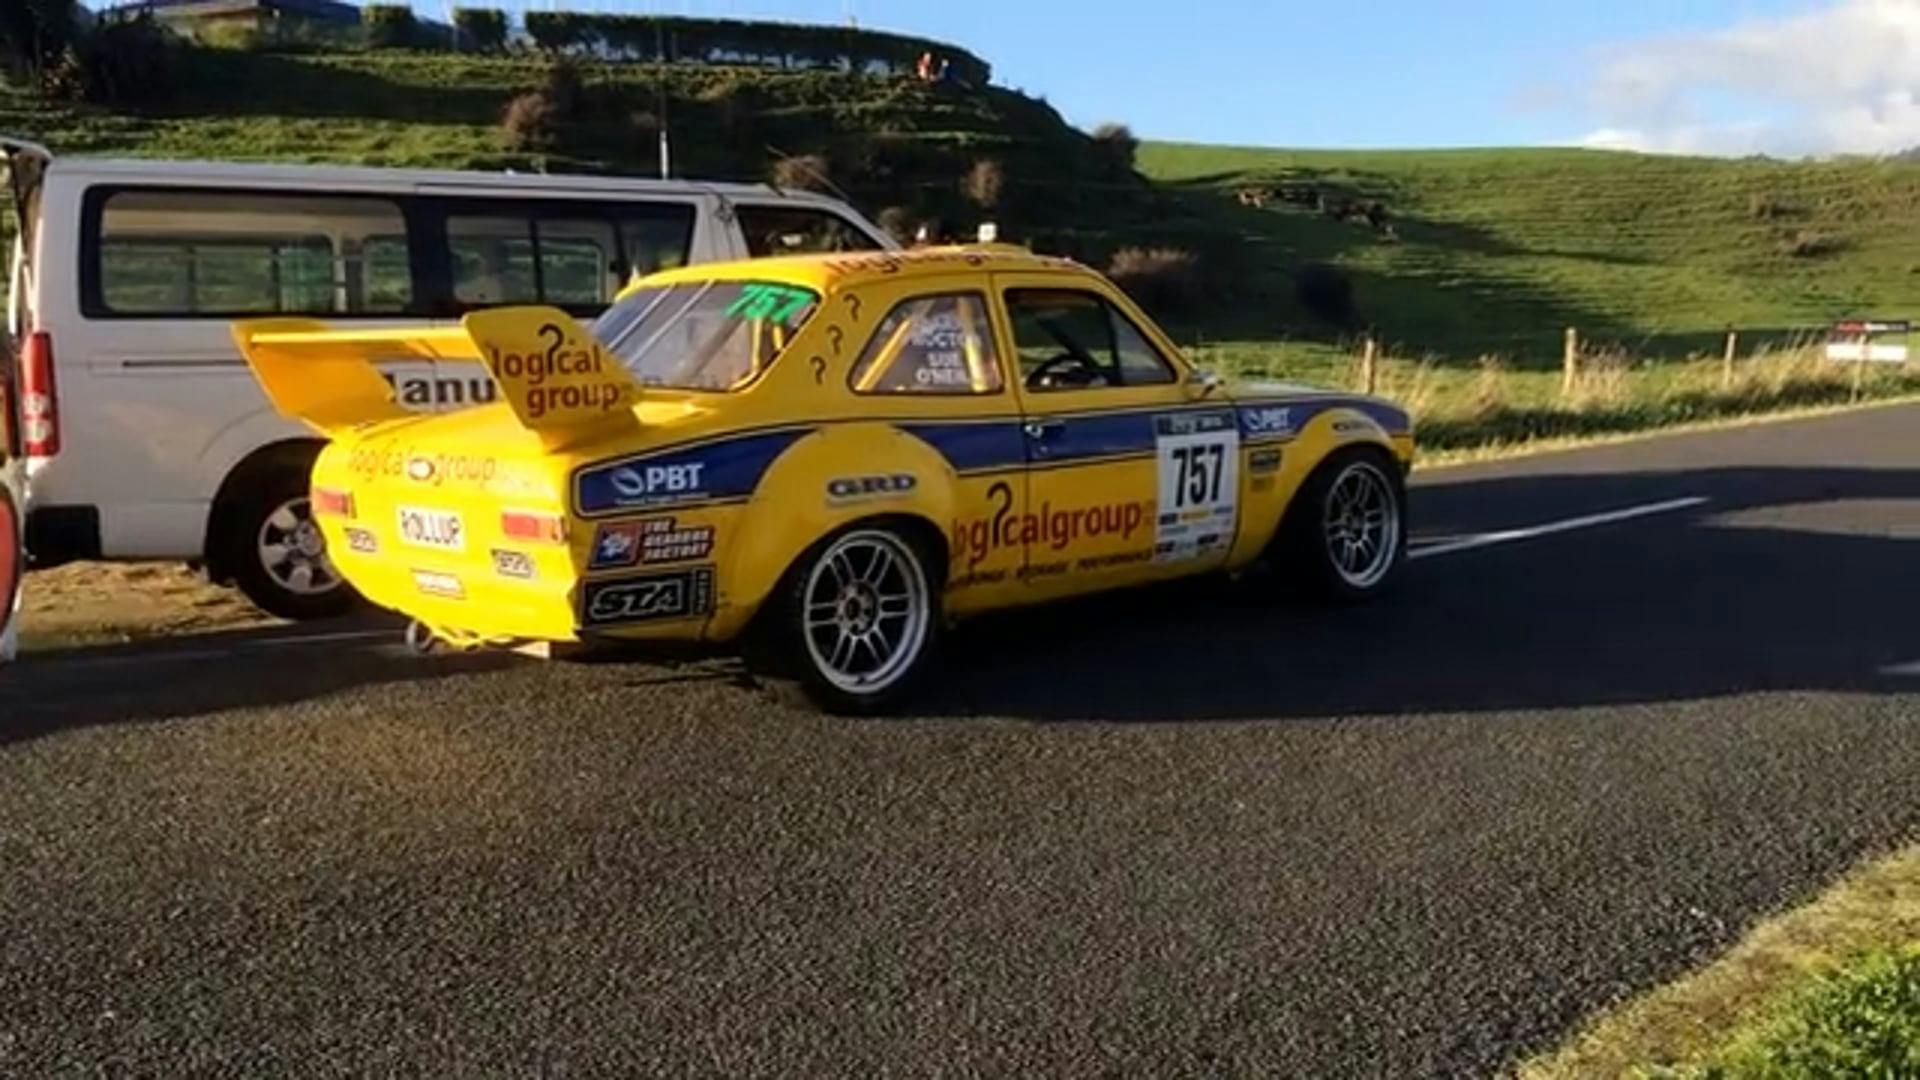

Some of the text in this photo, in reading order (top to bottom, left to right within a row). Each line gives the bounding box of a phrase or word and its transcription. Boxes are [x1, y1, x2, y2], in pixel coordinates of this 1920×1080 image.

[725, 284, 814, 322] 757
[387, 374, 497, 404] anu
[526, 382, 620, 418] group
[1262, 408, 1291, 430] PBT
[433, 452, 496, 489] group
[646, 463, 705, 492] PBT
[827, 474, 917, 498] GRD
[1172, 444, 1225, 508] 757
